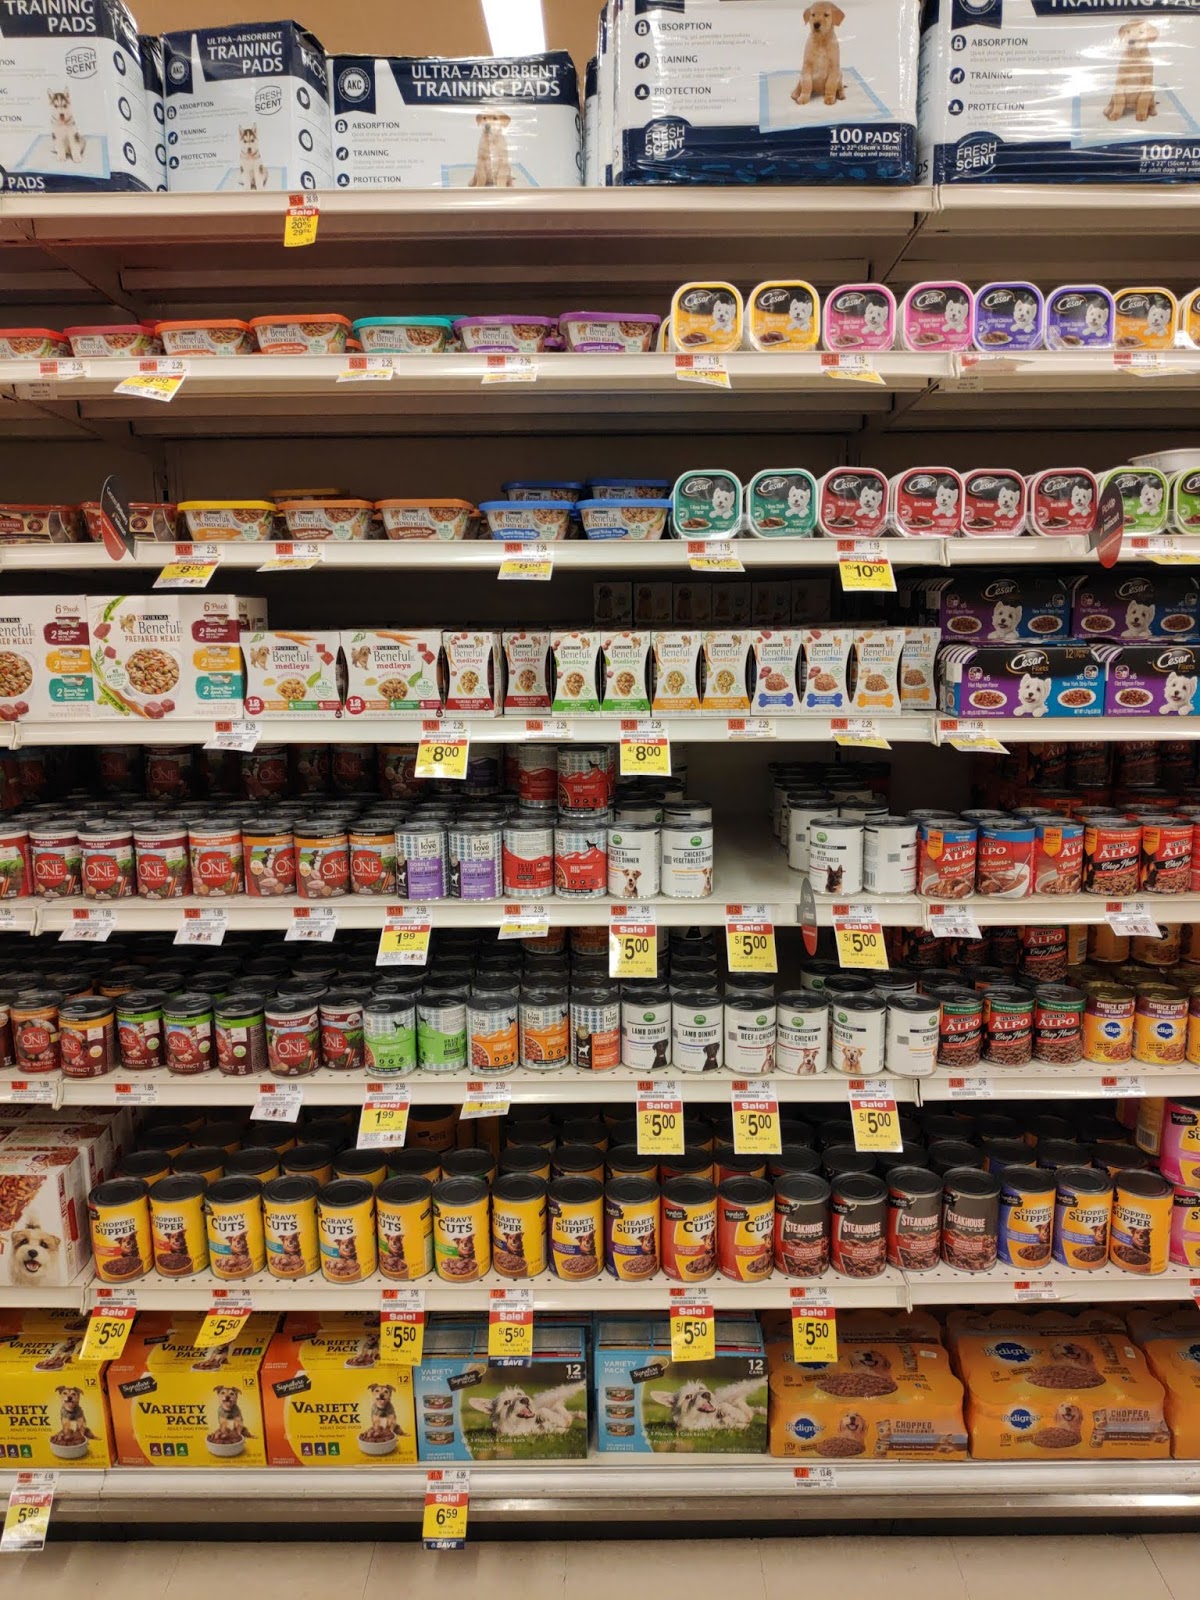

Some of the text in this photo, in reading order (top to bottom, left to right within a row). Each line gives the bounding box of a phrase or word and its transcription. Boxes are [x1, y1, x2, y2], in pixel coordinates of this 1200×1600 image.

[49, 16, 96, 32] PADS
[207, 31, 282, 45] ULTRA-ABSORBENT
[971, 38, 1028, 46] ABSORPTION
[207, 40, 282, 60] TRAINING
[65, 50, 96, 67] FRESH
[66, 61, 97, 75] SCENT
[172, 66, 184, 74] AKC
[242, 58, 283, 74] PADS
[412, 65, 560, 79] ULTRA-ABSORBENT
[971, 71, 1012, 79] TRAINING
[347, 81, 362, 90] AKC
[413, 80, 560, 97] TRAINING PADS
[654, 87, 711, 95] PROTECTION
[254, 88, 282, 104] FRESH
[179, 101, 214, 110] ABSORPTION
[255, 99, 282, 112] SCENT
[830, 129, 862, 143] 100
[957, 142, 997, 158] FRESH
[1141, 145, 1171, 160] 100
[181, 152, 217, 160] PROTECTION
[956, 156, 996, 171] SCENT
[8, 177, 45, 189] PADS
[916, 292, 943, 307] Cesar
[984, 292, 1012, 306] Cesar
[55, 605, 61, 614] 6
[204, 602, 209, 612] 6
[139, 621, 180, 634] Beneful
[199, 628, 205, 636] 2
[51, 631, 57, 639] 2
[273, 651, 311, 662] Beneful
[374, 651, 411, 662] Beneful
[454, 649, 483, 657] Beneful
[1011, 652, 1045, 670] Cesar
[1159, 651, 1191, 668] Cesar
[57, 689, 62, 697] 2
[1098, 846, 1136, 858] ALPO
[36, 863, 62, 875] ONE
[86, 865, 114, 877] ONE
[139, 864, 166, 876] ONE
[200, 862, 227, 873] ONE
[946, 1020, 980, 1032] ALPO
[992, 1018, 1029, 1029] ALPO
[1038, 1018, 1074, 1027] ALPO
[632, 1026, 666, 1035] LAMB DINNER
[1020, 1206, 1052, 1214] CHOPPED
[266, 1217, 298, 1230] CUTS
[623, 1217, 654, 1226] HEARTY
[901, 1214, 939, 1227] STEAKHOUSE
[947, 1210, 985, 1227] STEAKHOUSE
[1069, 1213, 1108, 1223] SUPPER
[95, 1225, 136, 1236] SUPPER
[212, 1219, 245, 1232] CUTS
[321, 1221, 353, 1234] CUTS
[438, 1219, 472, 1233] CUTS
[556, 1222, 594, 1233] SUPPER
[617, 1223, 654, 1234] SUPPER
[786, 1222, 822, 1233] STEAKHOUSE
[843, 1221, 880, 1233] STEAKHOUSE
[679, 1307, 705, 1315] Sale!
[984, 1347, 1041, 1357] Pedigree
[566, 1365, 581, 1375] 12
[749, 1360, 763, 1370] 12
[139, 1403, 205, 1414] VARIETY
[292, 1402, 359, 1413] VARIETY
[9, 1416, 50, 1425] PACK
[167, 1416, 207, 1424] PACK
[319, 1415, 361, 1424] PACK
[1002, 1414, 1040, 1422] Pedigree
[786, 1424, 825, 1432] Pedigree
[896, 1421, 932, 1429] CHOPPED
